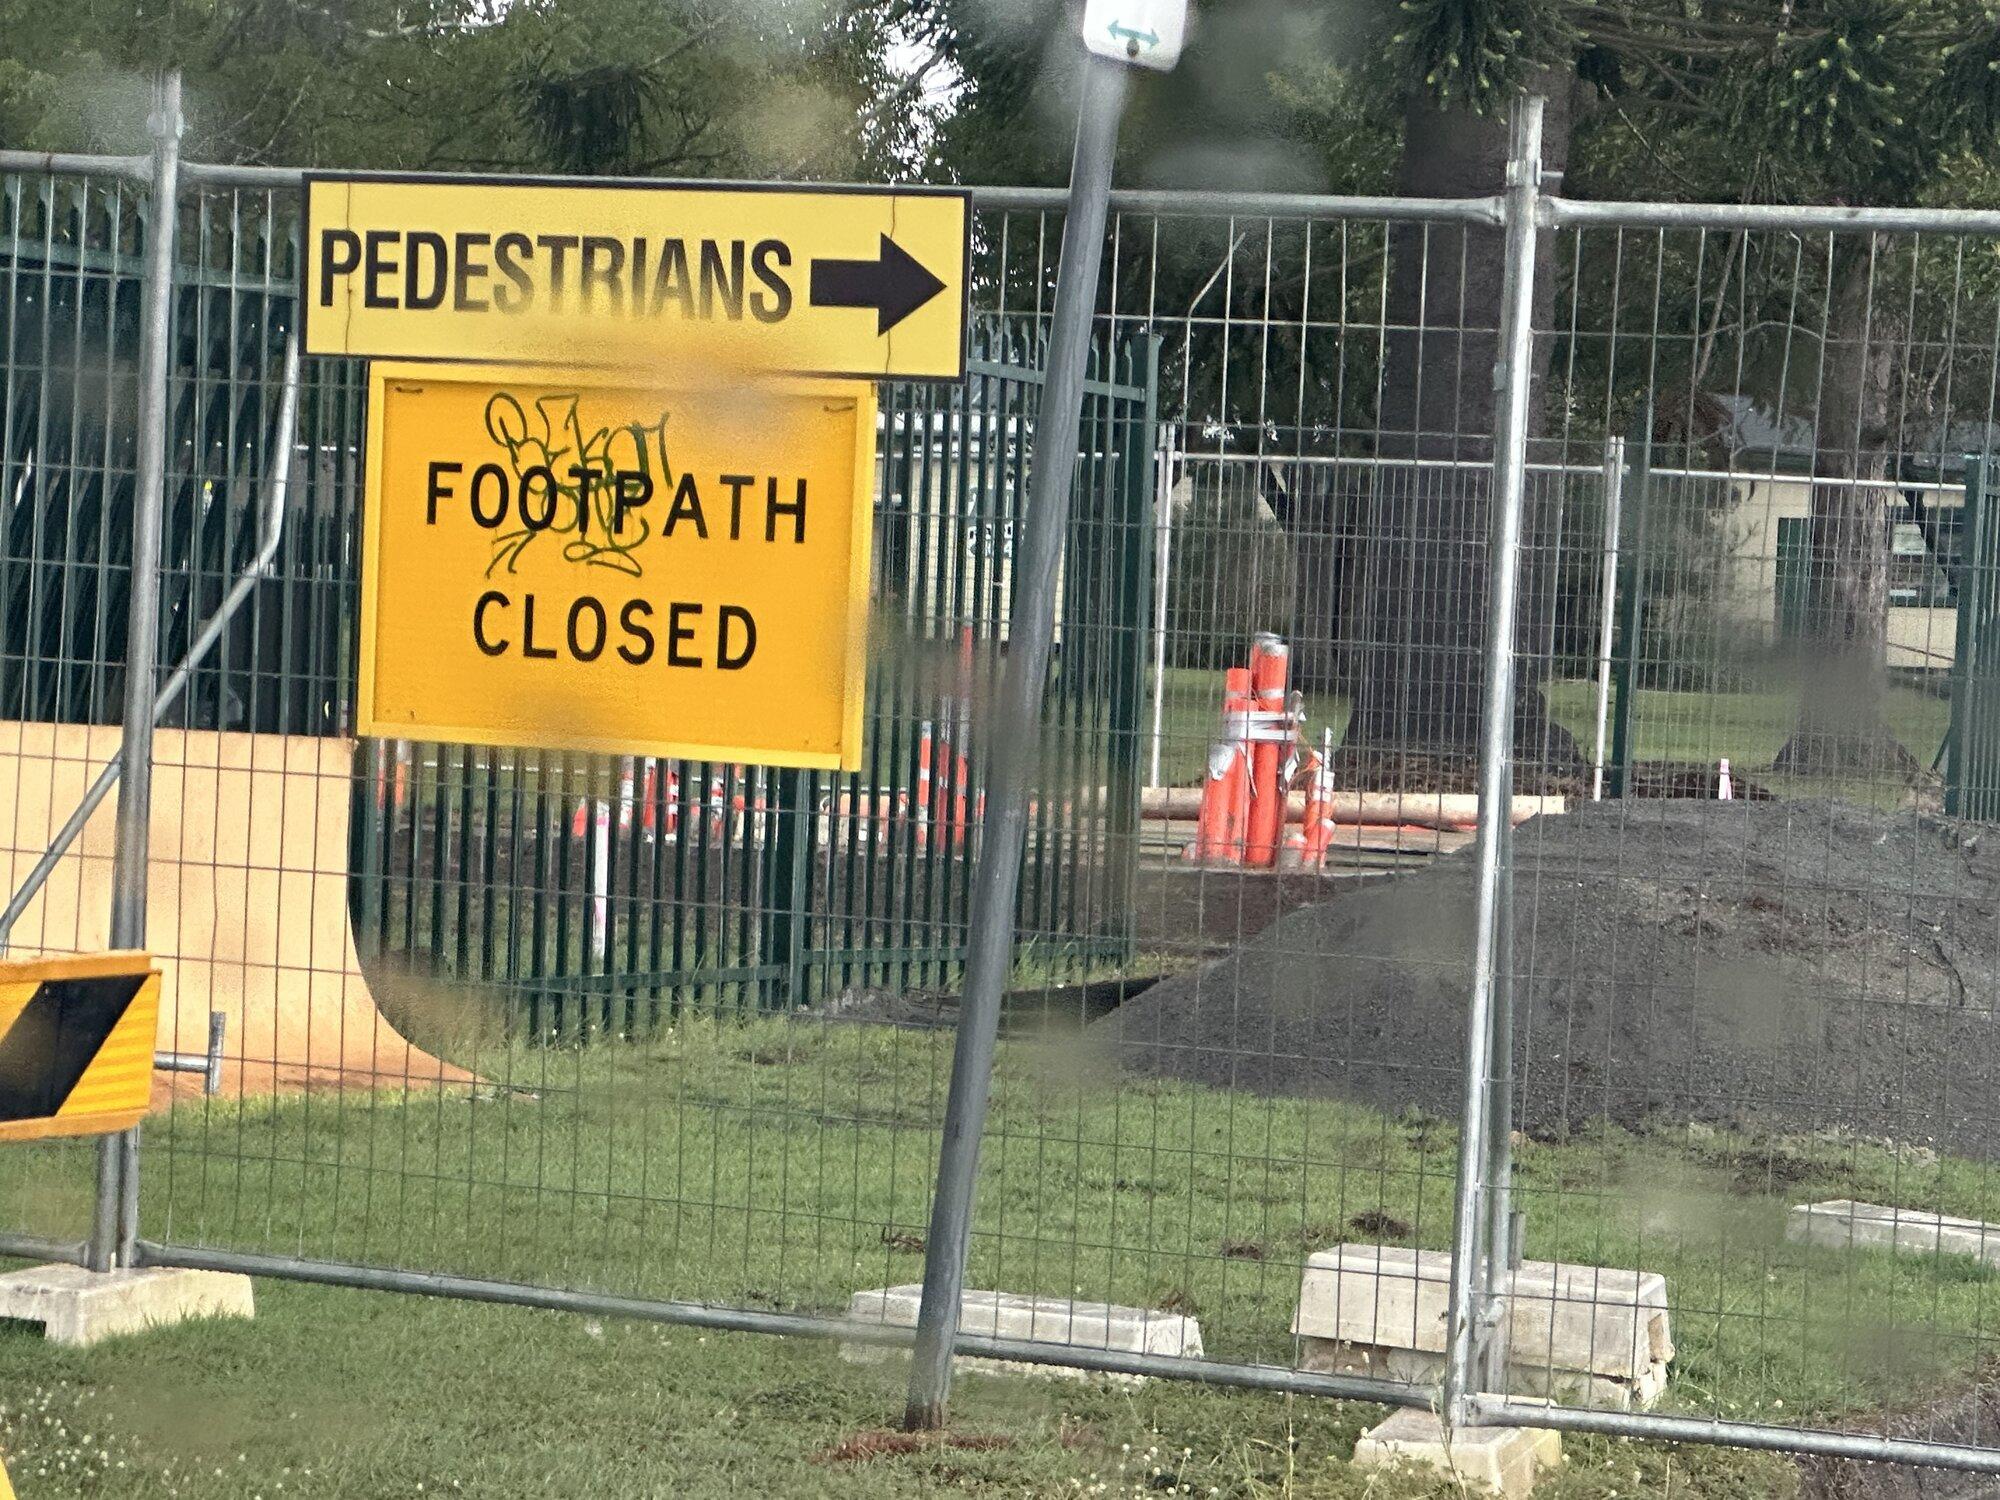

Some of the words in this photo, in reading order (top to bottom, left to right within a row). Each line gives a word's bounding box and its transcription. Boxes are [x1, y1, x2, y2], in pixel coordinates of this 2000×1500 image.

[320, 228, 793, 323] PEDESTRIANS
[426, 462, 808, 544] FOOTPATH
[472, 590, 758, 671] CLOSED
